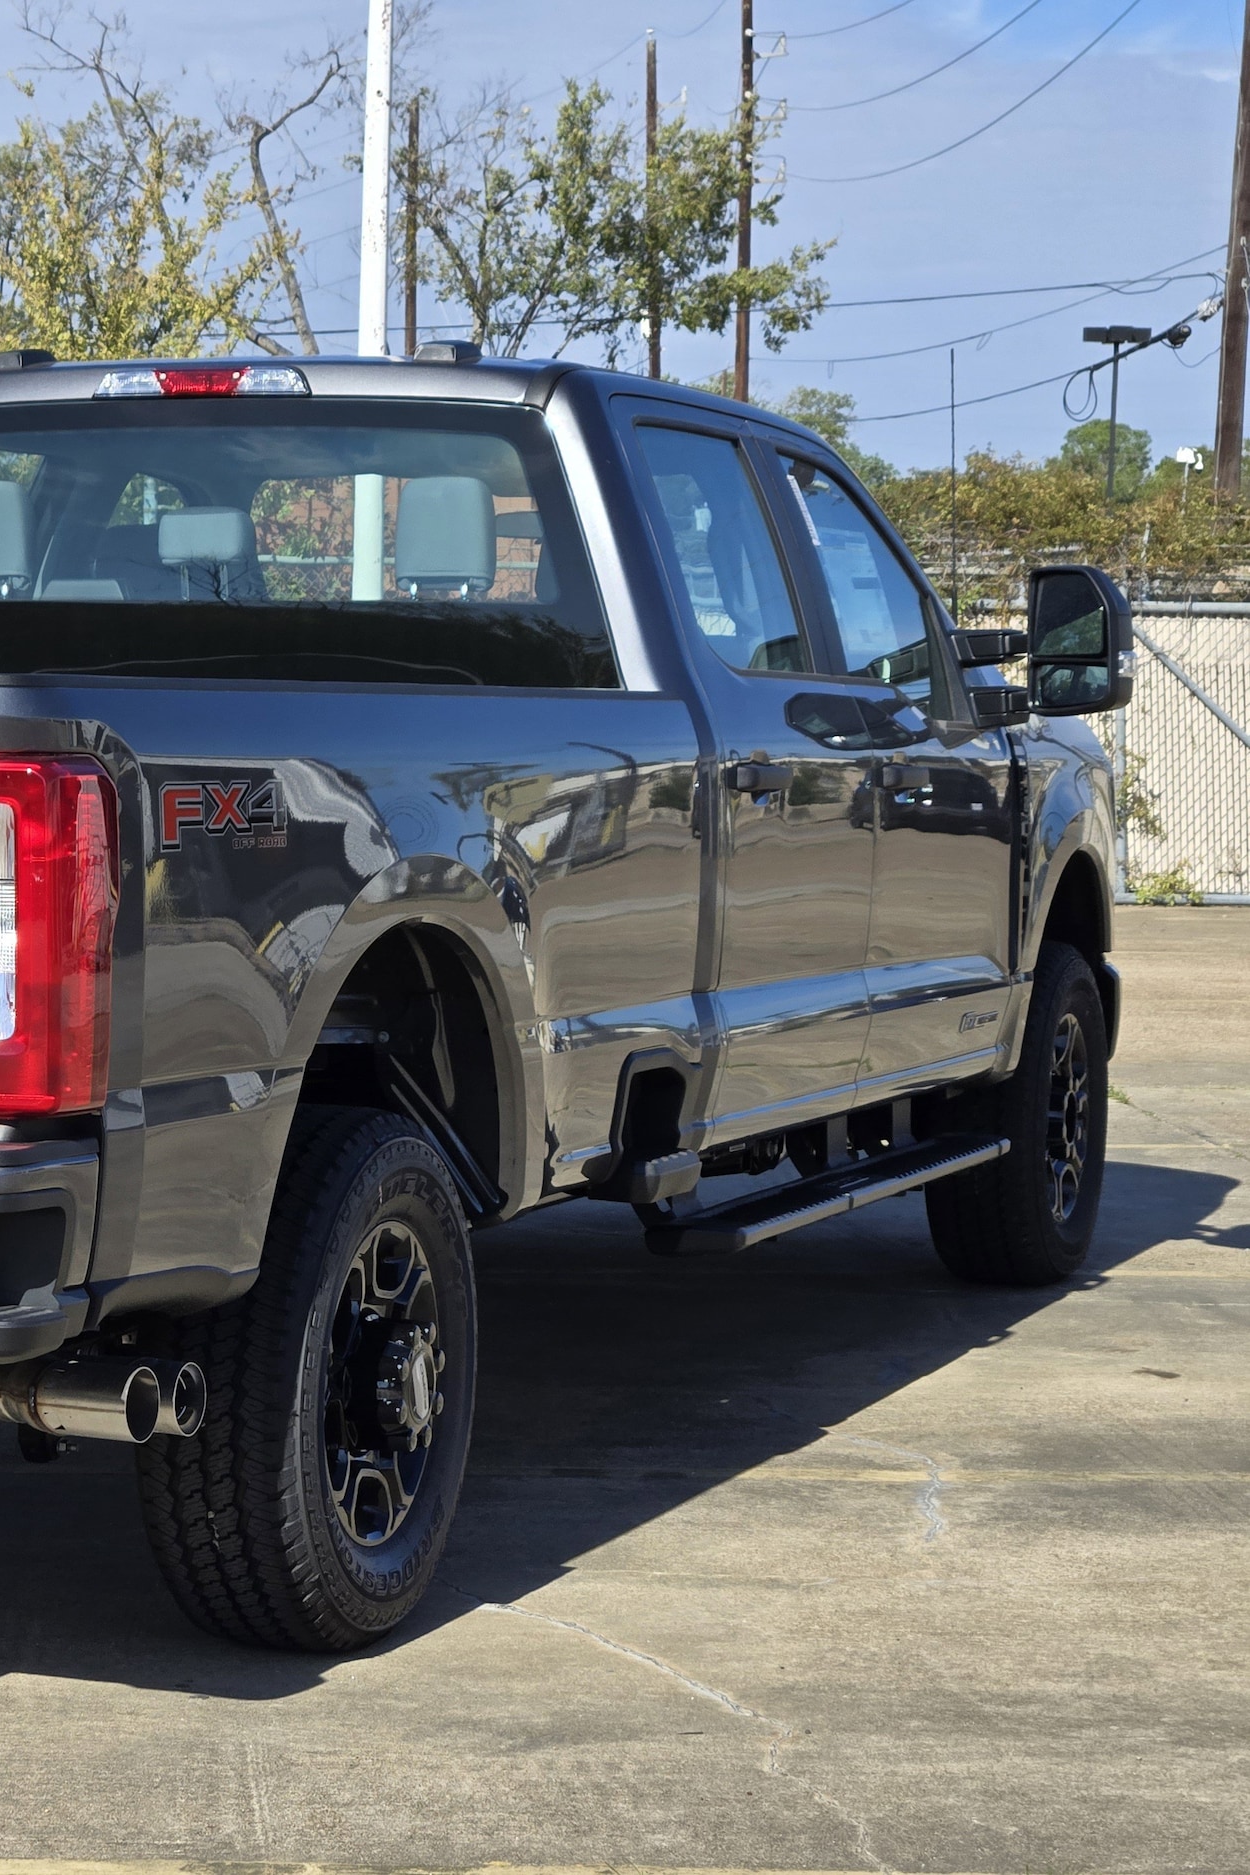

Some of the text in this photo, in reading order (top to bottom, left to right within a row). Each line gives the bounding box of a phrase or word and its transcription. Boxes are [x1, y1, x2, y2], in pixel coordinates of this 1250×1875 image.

[158, 778, 288, 853] FX4
[232, 836, 287, 849] OFF ROAD
